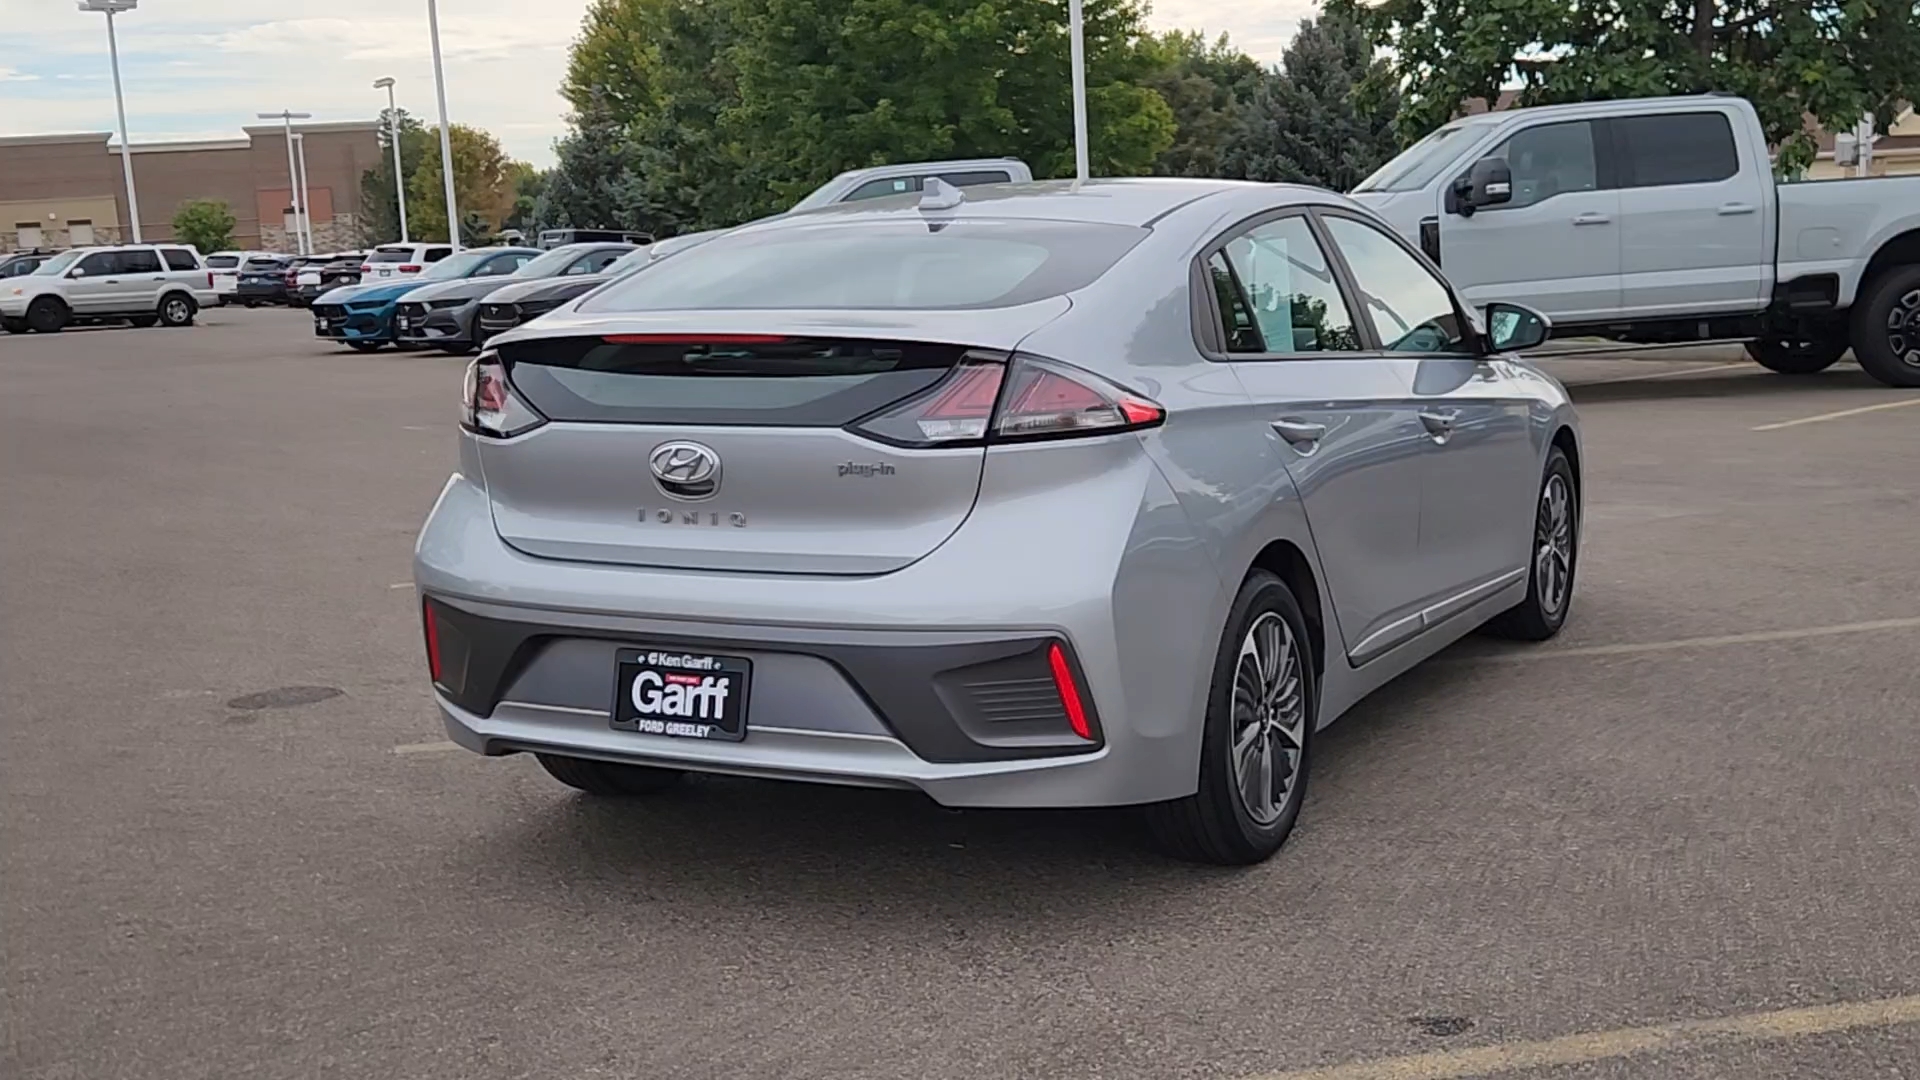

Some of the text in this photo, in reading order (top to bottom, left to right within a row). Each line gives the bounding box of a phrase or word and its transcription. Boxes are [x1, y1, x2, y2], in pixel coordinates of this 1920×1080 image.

[837, 461, 896, 477] plug-in
[637, 507, 747, 528] IONIQ
[658, 653, 713, 670] Ken Garff
[631, 670, 730, 719] Garff
[638, 719, 711, 738] FORD GREELEY
